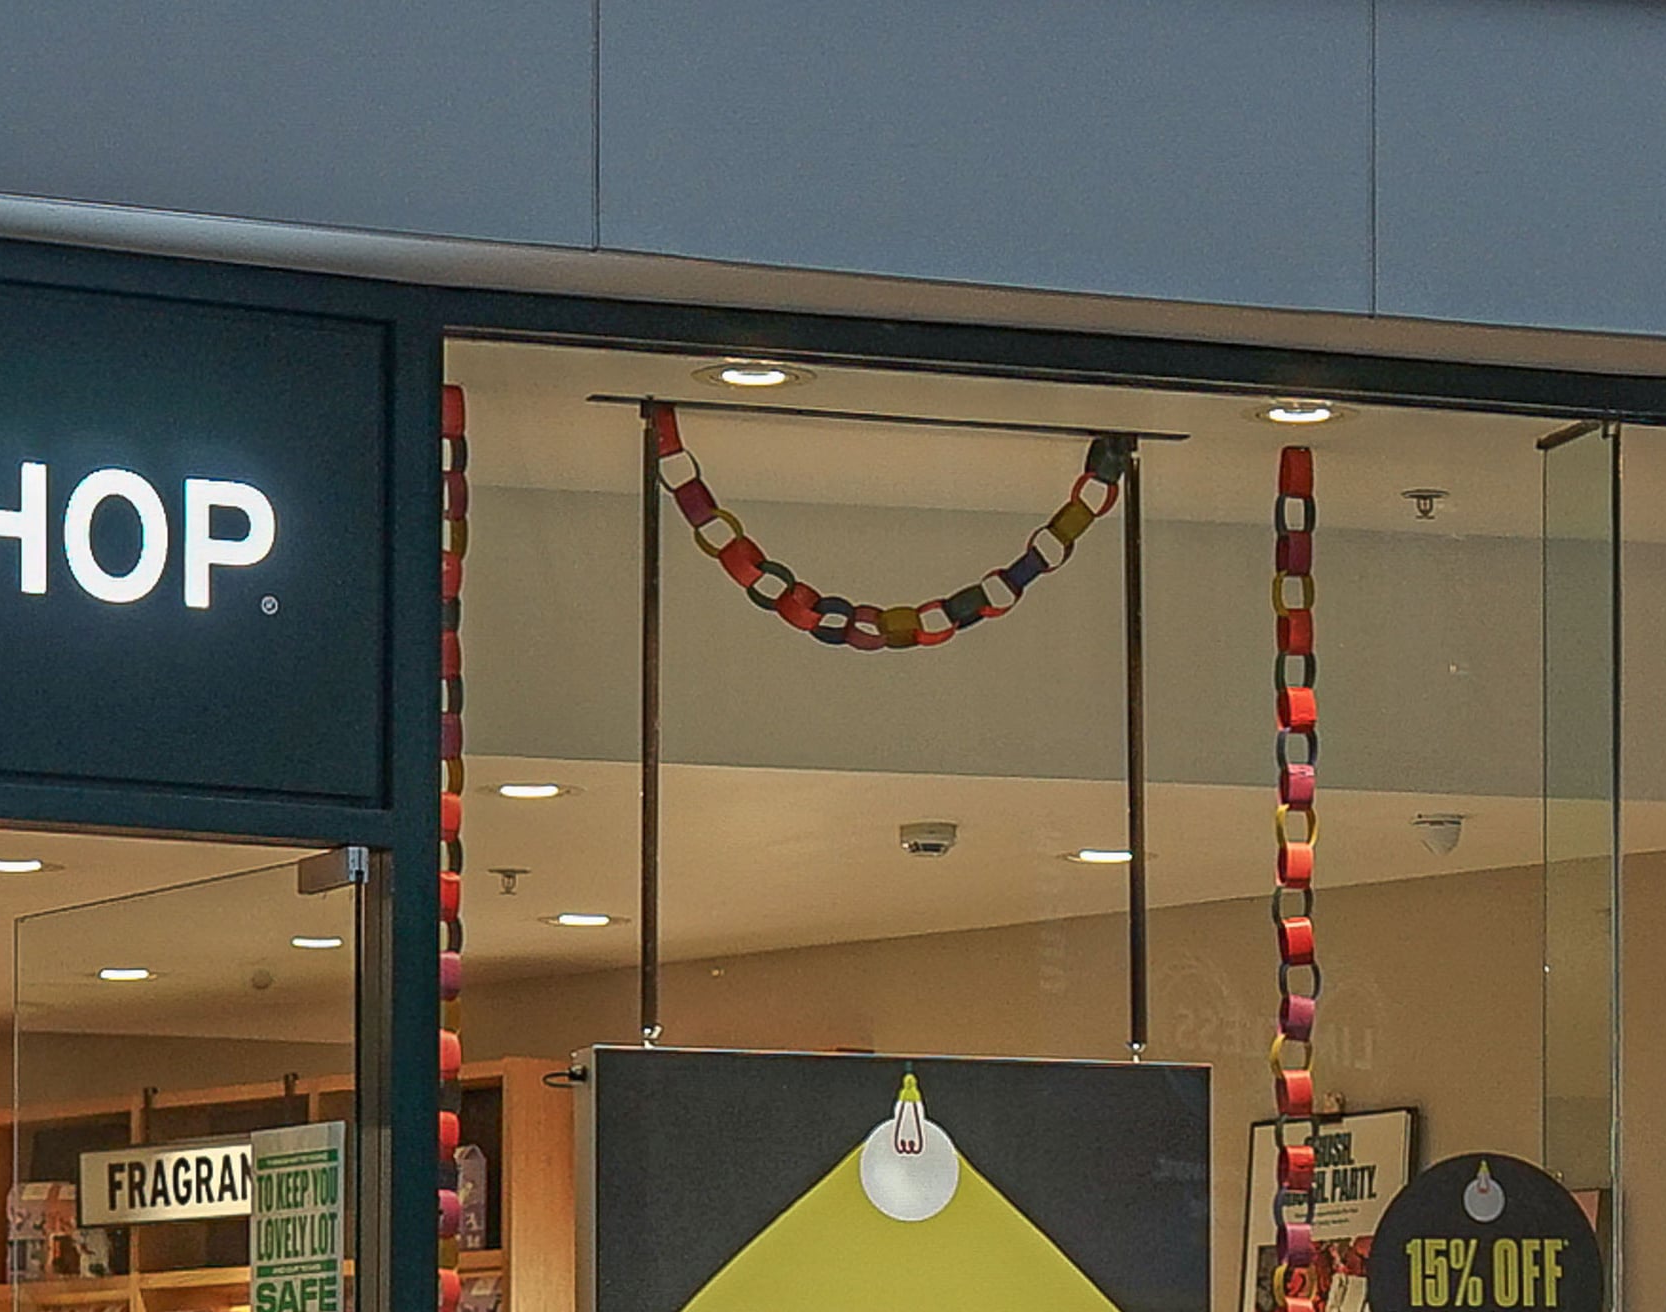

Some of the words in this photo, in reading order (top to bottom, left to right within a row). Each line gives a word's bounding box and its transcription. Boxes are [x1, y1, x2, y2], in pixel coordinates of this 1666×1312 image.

[256, 1173, 273, 1214] TO
[276, 1169, 310, 1211] KEEP
[312, 1164, 339, 1207] YOU
[256, 1214, 308, 1262] LOVELY
[311, 1210, 338, 1256] LOT
[1405, 1238, 1483, 1308] 15%
